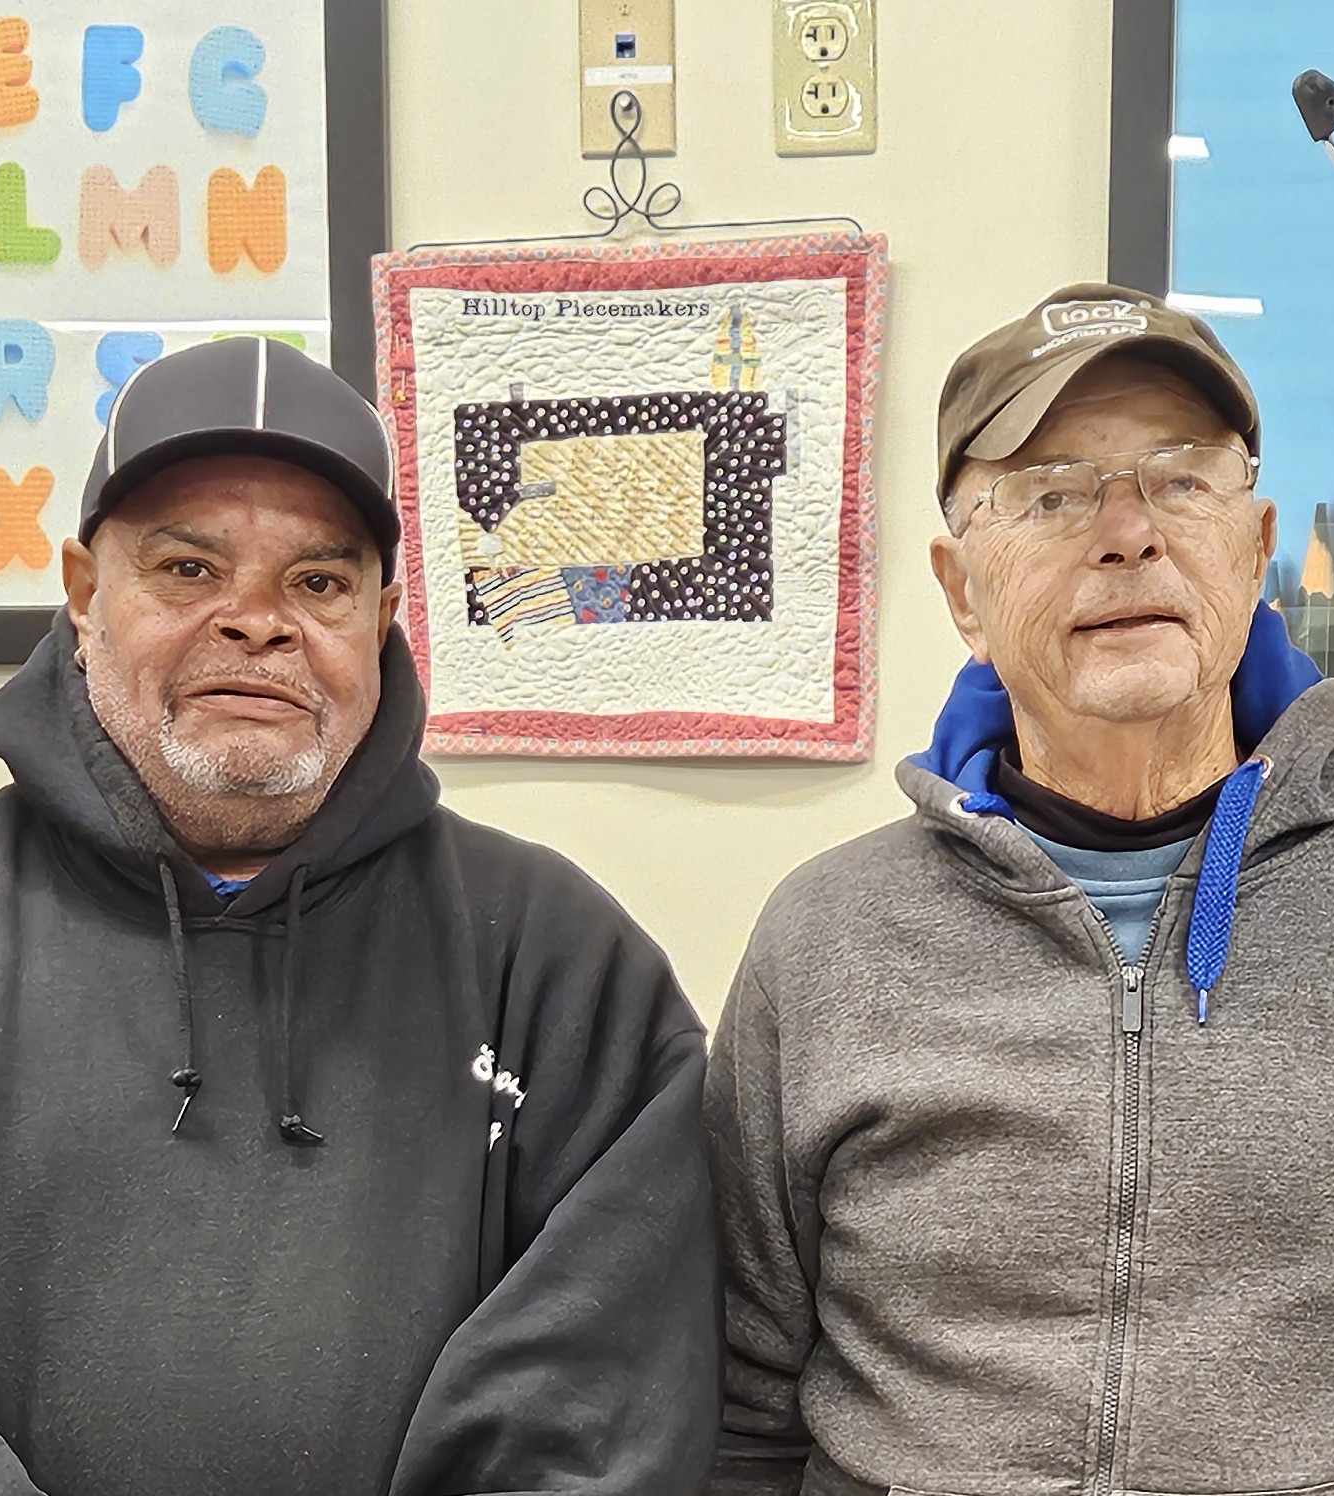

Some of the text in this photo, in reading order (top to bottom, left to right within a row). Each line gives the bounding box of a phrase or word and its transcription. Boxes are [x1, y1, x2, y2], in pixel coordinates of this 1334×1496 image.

[81, 25, 144, 132] F
[189, 26, 268, 134] G
[78, 164, 181, 268] M
[207, 165, 287, 274] N
[462, 298, 710, 321] Hilltop Piecemakers
